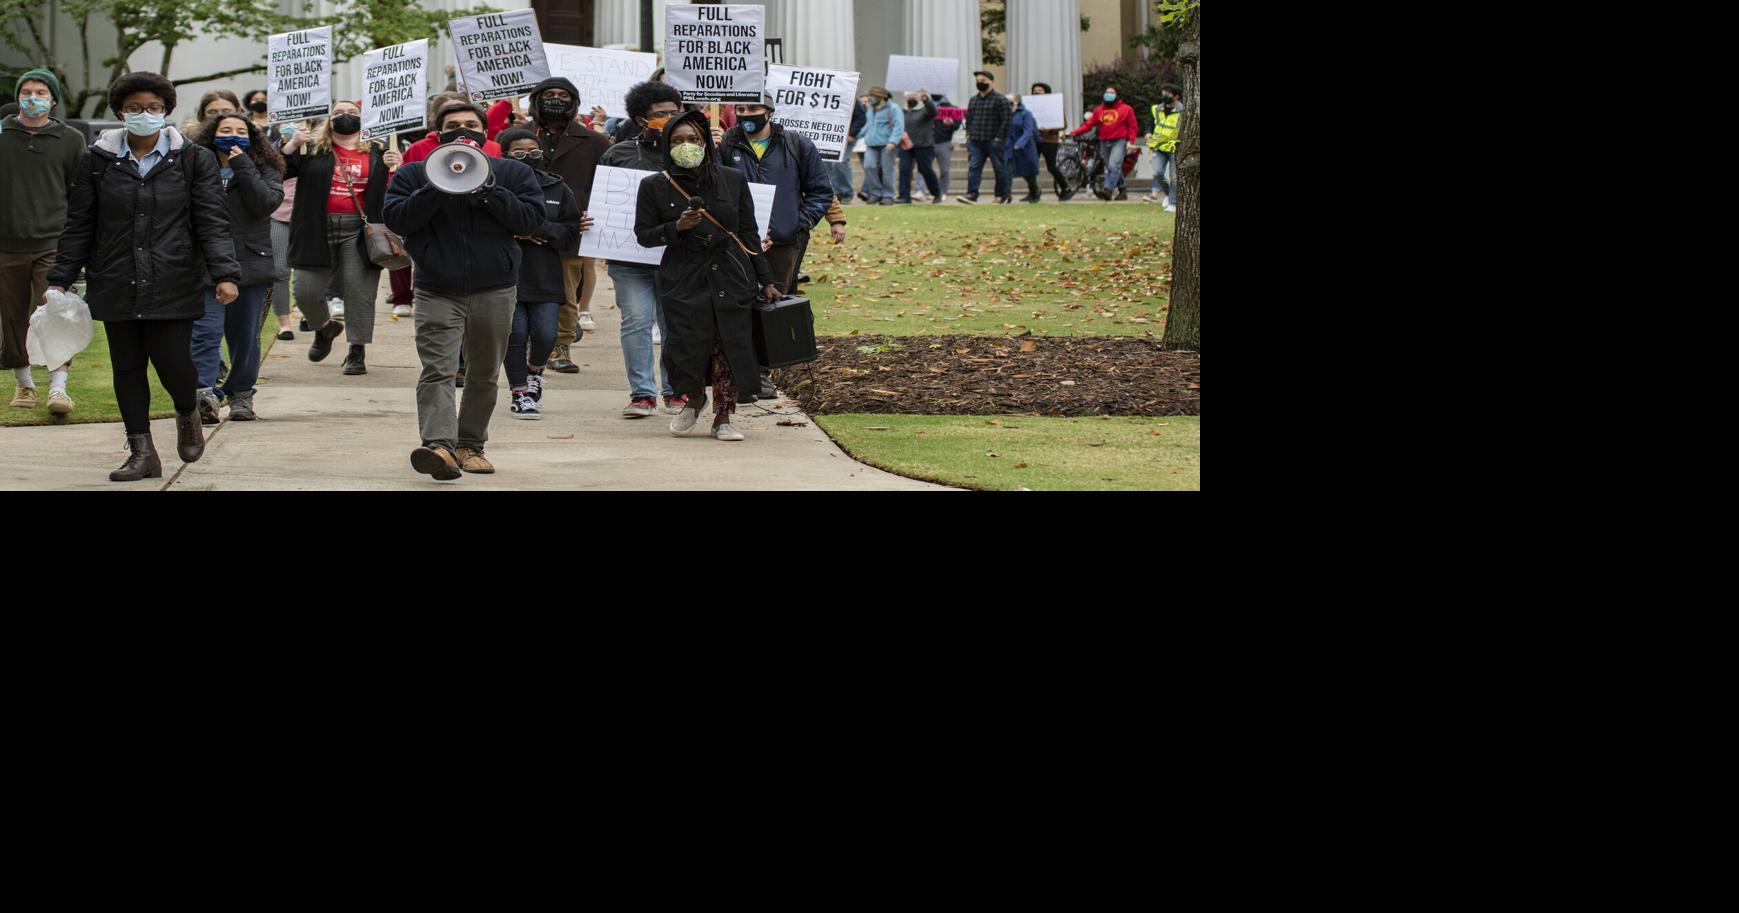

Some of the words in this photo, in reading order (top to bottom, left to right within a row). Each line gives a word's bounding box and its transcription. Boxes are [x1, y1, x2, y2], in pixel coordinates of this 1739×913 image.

[476, 14, 508, 29] FULL
[698, 7, 732, 21] FULL
[287, 31, 310, 46] FULL
[460, 26, 532, 46] REPARATIONS
[673, 24, 756, 37] REPARATIONS
[272, 44, 326, 63] REPARATIONS
[382, 45, 406, 61] FULL
[468, 46, 492, 60] FOR
[493, 40, 532, 56] BLACK
[678, 40, 704, 53] FOR
[708, 41, 751, 55] BLACK
[275, 64, 292, 78] FOR
[294, 60, 323, 75] BLACK
[366, 57, 422, 79] REPARATIONS
[476, 54, 532, 73] AMERICA
[584, 55, 650, 77] STAND
[682, 56, 747, 71] AMERICA
[277, 74, 320, 92] AMERICA
[368, 79, 386, 94] FOR
[387, 72, 417, 90] BLACK
[491, 71, 525, 87] NOW!
[696, 75, 733, 89] NOW!
[789, 70, 835, 89] FIGHT
[286, 93, 311, 108] NOW!
[371, 86, 413, 108] AMERICA
[775, 89, 806, 106] FOR
[809, 91, 841, 110] $15
[379, 105, 404, 123] NOW!
[780, 117, 810, 129] BOSSES
[810, 121, 833, 132] NEED
[833, 124, 845, 133] US
[821, 133, 844, 144] THEM
